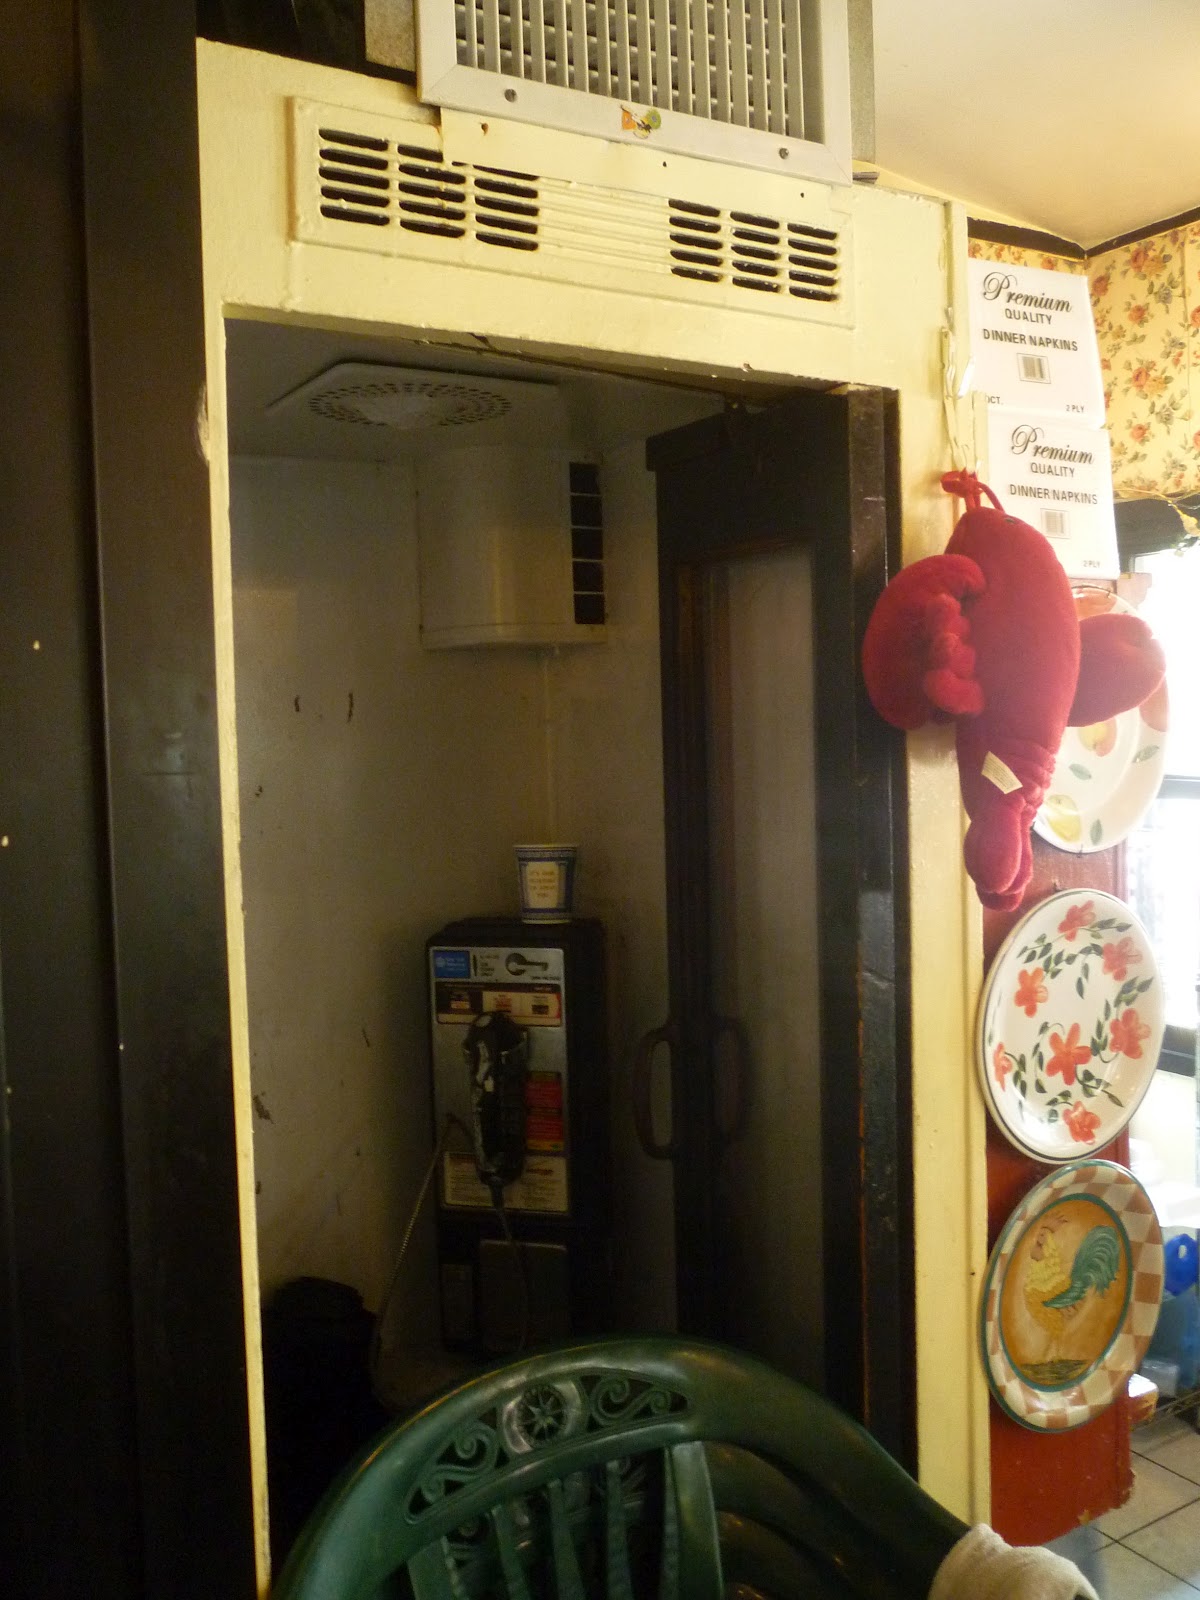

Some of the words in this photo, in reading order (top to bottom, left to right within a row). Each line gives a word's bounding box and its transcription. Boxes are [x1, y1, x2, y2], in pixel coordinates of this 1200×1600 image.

[983, 272, 1072, 312] Premium
[1004, 308, 1052, 325] QUALITY
[983, 328, 1026, 345] DINNER
[1029, 335, 1078, 351] NAPKINS
[1071, 405, 1085, 413] PLY
[1011, 424, 1094, 464] Premium
[1030, 462, 1075, 478] QUALITY
[1009, 484, 1050, 499] DINNER
[1053, 489, 1098, 505] NAPKINS
